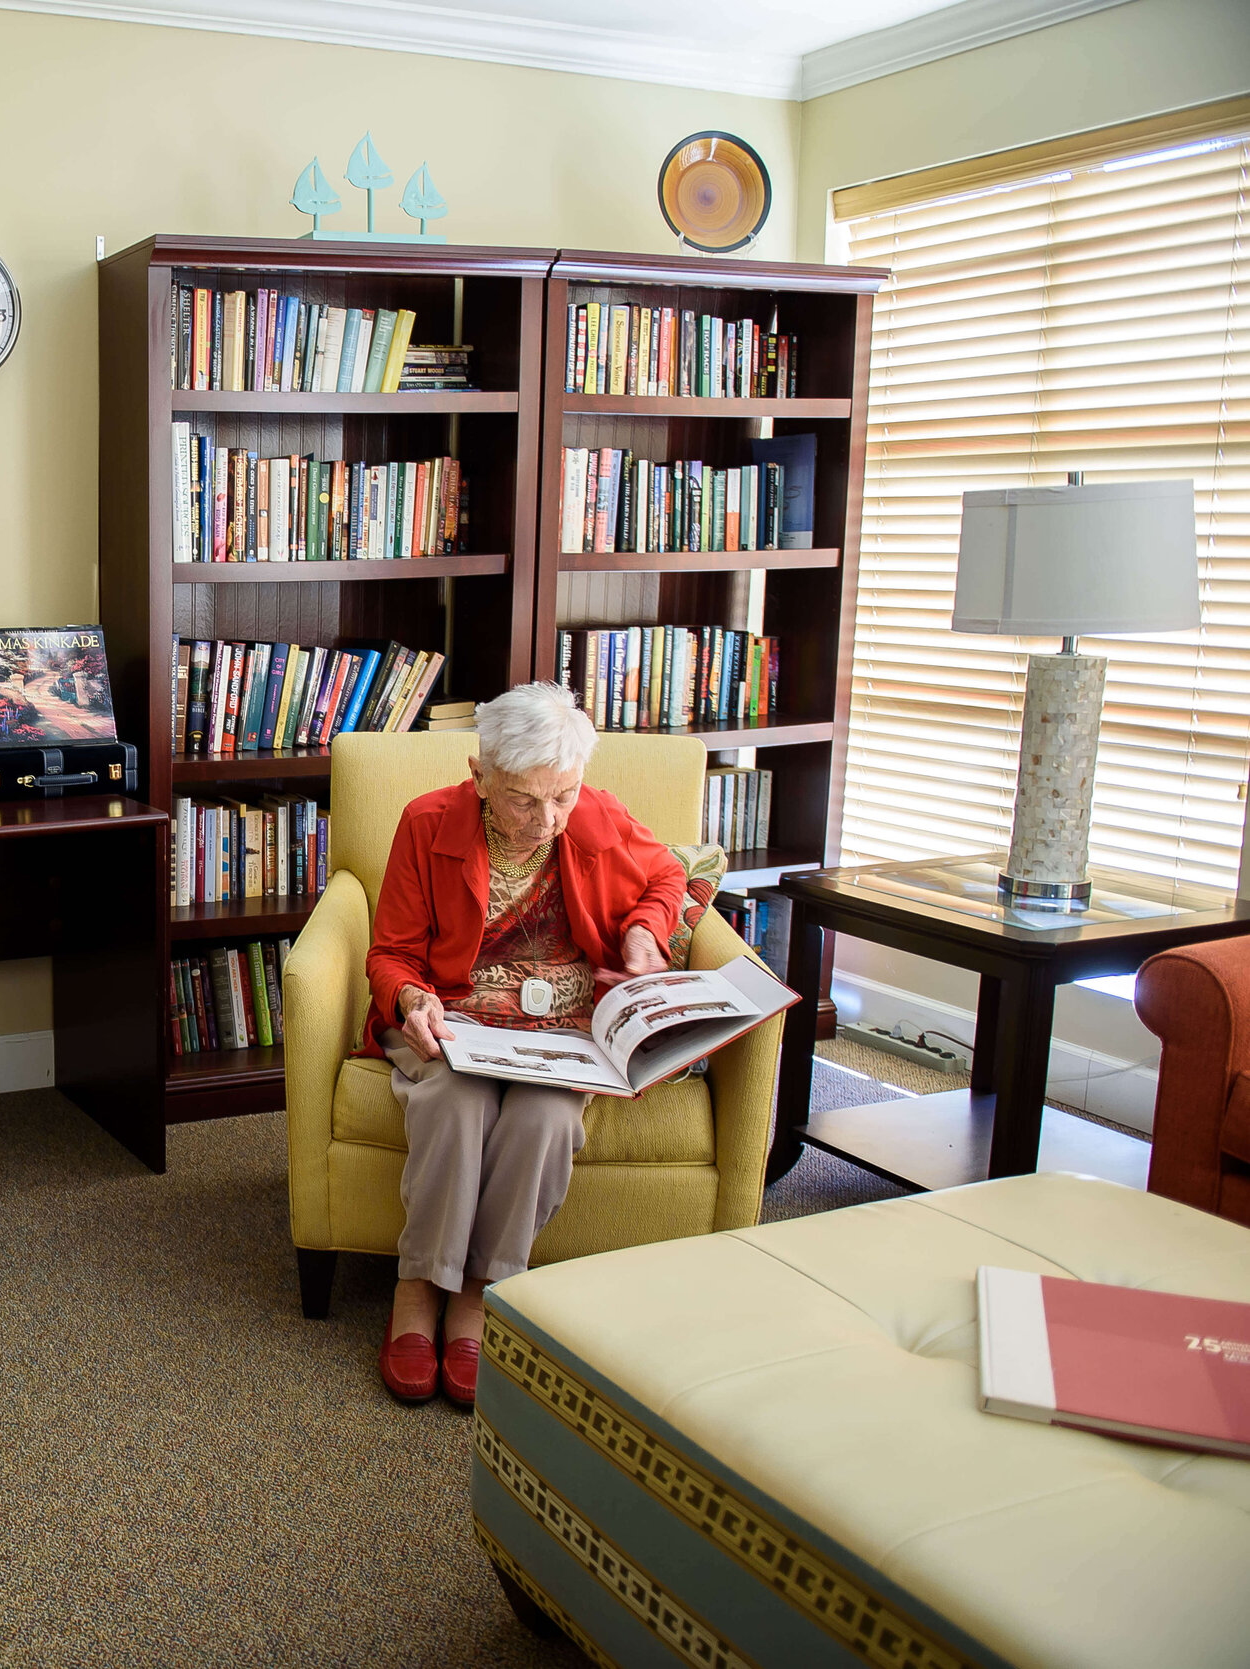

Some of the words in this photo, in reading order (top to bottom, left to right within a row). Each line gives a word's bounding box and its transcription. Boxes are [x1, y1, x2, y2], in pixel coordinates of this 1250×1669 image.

[615, 320, 624, 352] Stonewall
[614, 365, 622, 387] Valley
[179, 437, 187, 485] PRINTED
[589, 453, 597, 475] DAMAGE
[181, 488, 189, 536] SOURCES
[34, 635, 99, 649] KINKADE
[563, 635, 572, 667] Griffin
[616, 633, 625, 648] Tom
[234, 648, 242, 668] JOHN
[613, 649, 624, 673] Clancy
[229, 670, 240, 709] SANDFORD
[344, 672, 356, 696] COTTINGLEY
[340, 697, 349, 713] SECRET
[267, 823, 275, 844] ROBERT
[267, 845, 275, 869] LUDLUM
[252, 946, 260, 961] Janet
[254, 962, 262, 986] Evanovich
[1184, 1336, 1221, 1352] 25
